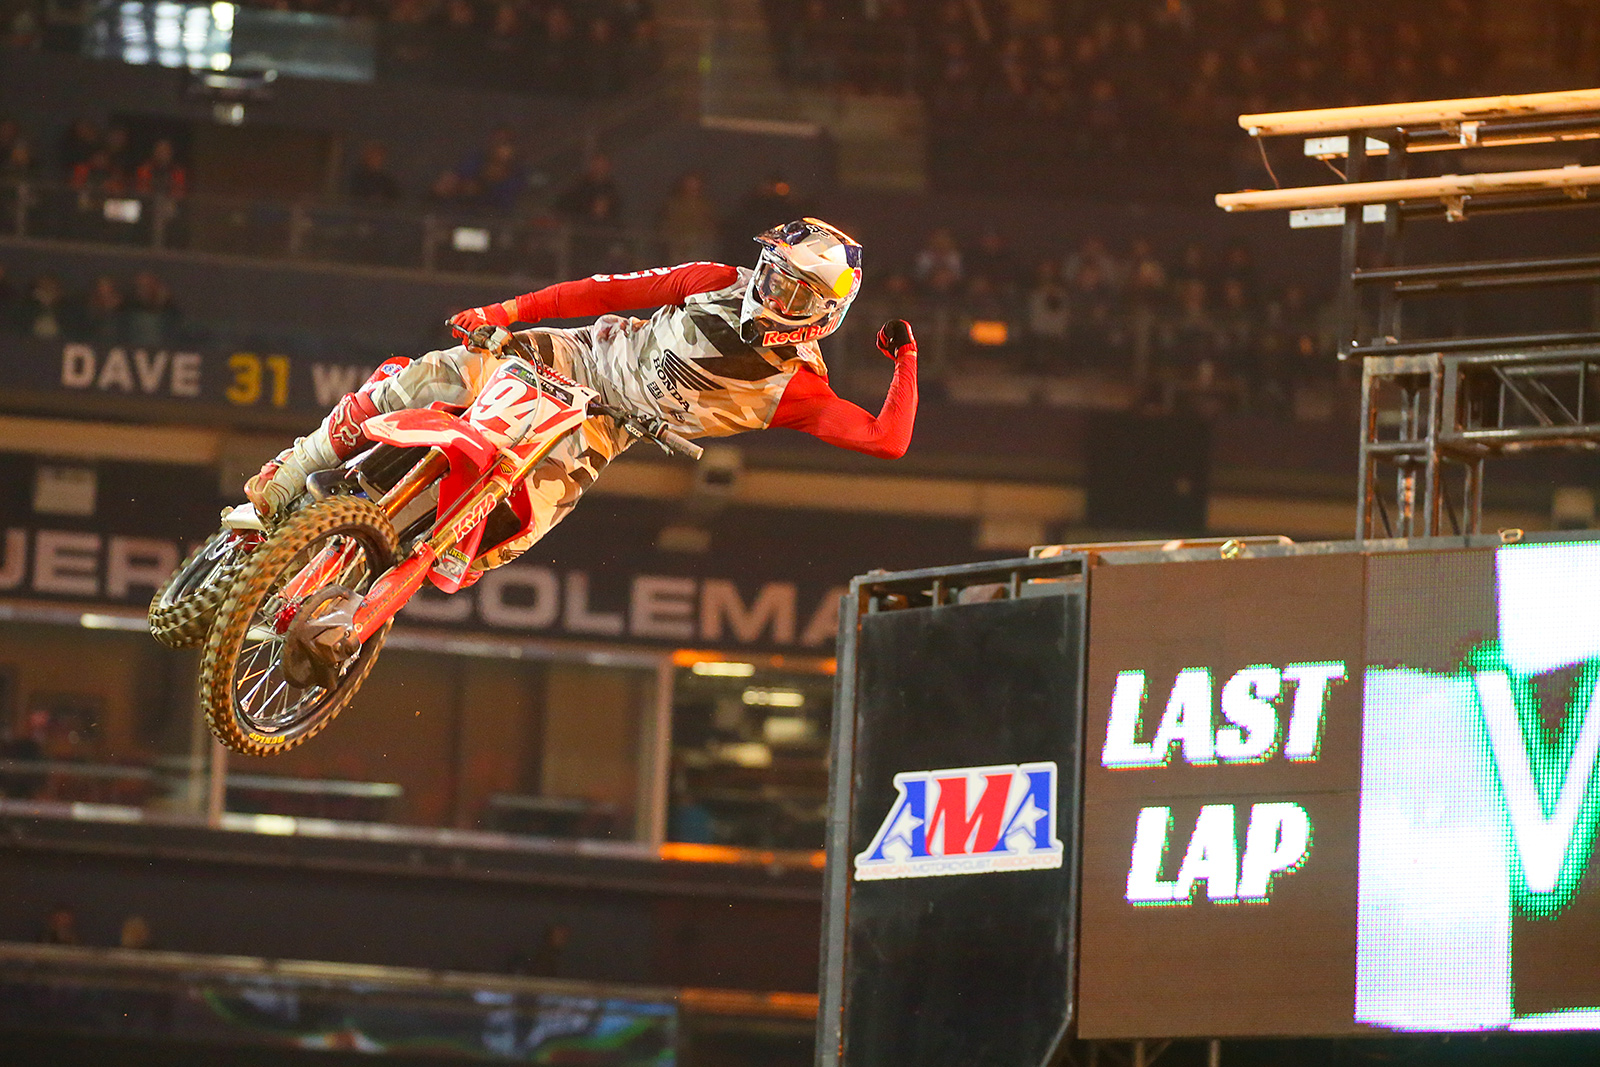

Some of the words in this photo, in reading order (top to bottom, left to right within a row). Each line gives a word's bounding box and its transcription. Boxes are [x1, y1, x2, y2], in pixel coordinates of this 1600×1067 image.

[763, 328, 806, 347] Red
[804, 315, 840, 341] Bull
[60, 342, 202, 397] DAVE
[226, 353, 290, 407] 31
[652, 356, 690, 412] HONDA
[469, 378, 562, 442] 94
[451, 492, 498, 544] KYB
[0, 528, 202, 598] JER
[249, 732, 286, 745] DUNLOP
[1101, 661, 1349, 768] LAST
[862, 768, 1060, 861] AMA
[859, 864, 911, 877] AMERICAN
[1126, 802, 1315, 906] LAP
